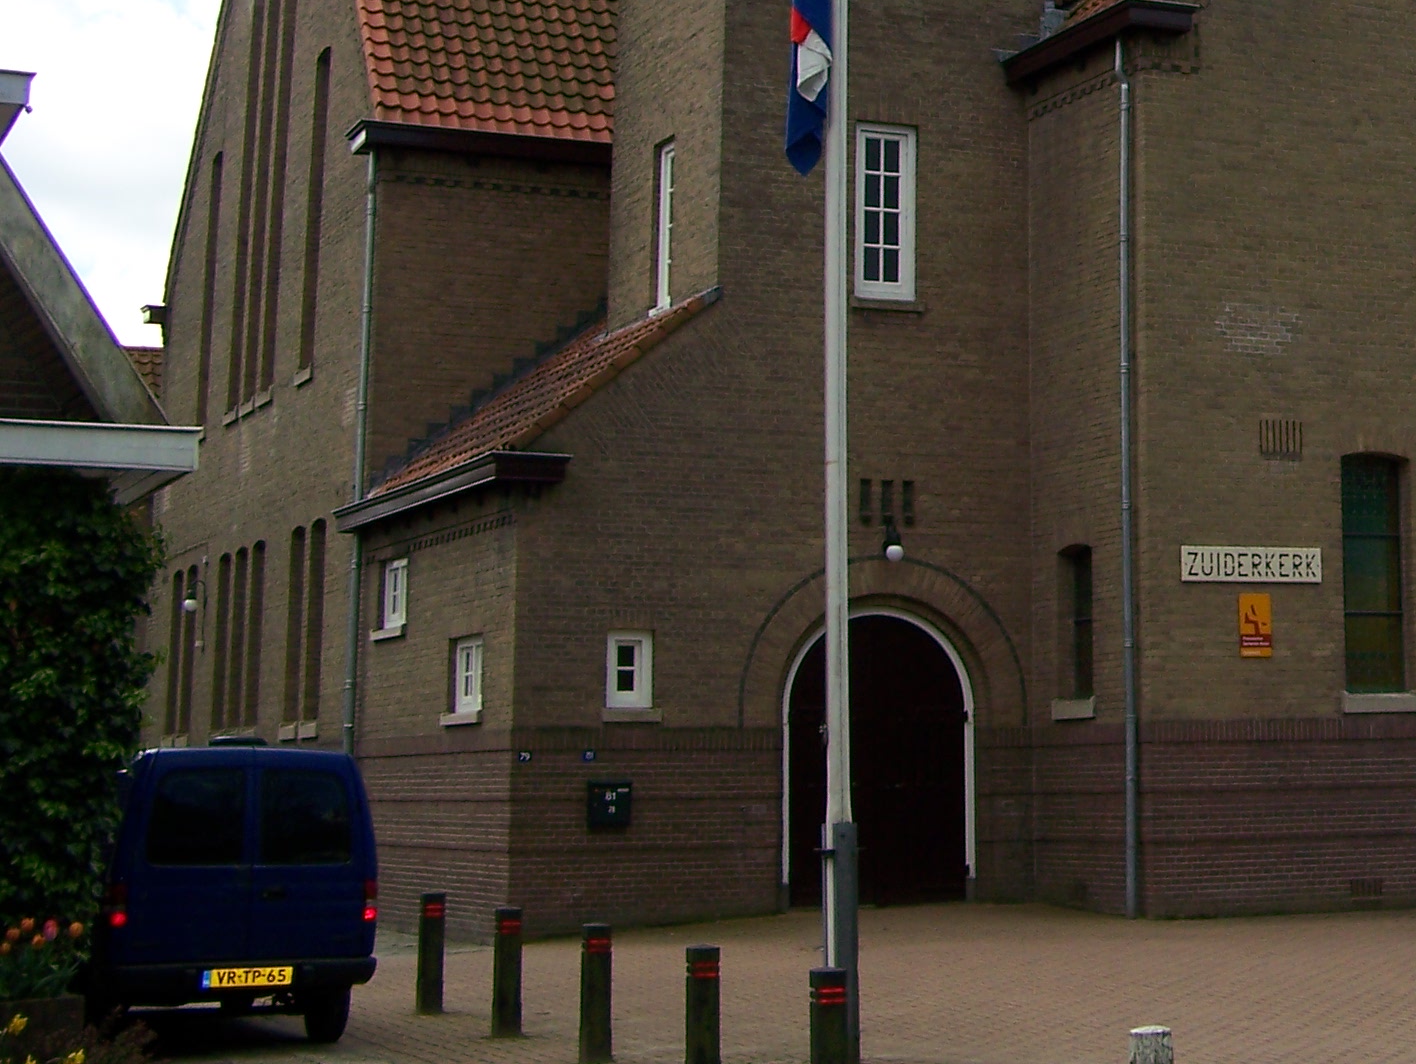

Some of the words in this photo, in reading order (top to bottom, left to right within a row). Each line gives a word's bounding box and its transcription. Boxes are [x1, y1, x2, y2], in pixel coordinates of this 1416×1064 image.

[1187, 552, 1317, 577] ZUIDERKERK
[519, 752, 531, 761] 79
[217, 969, 286, 985] VR-TP-65
